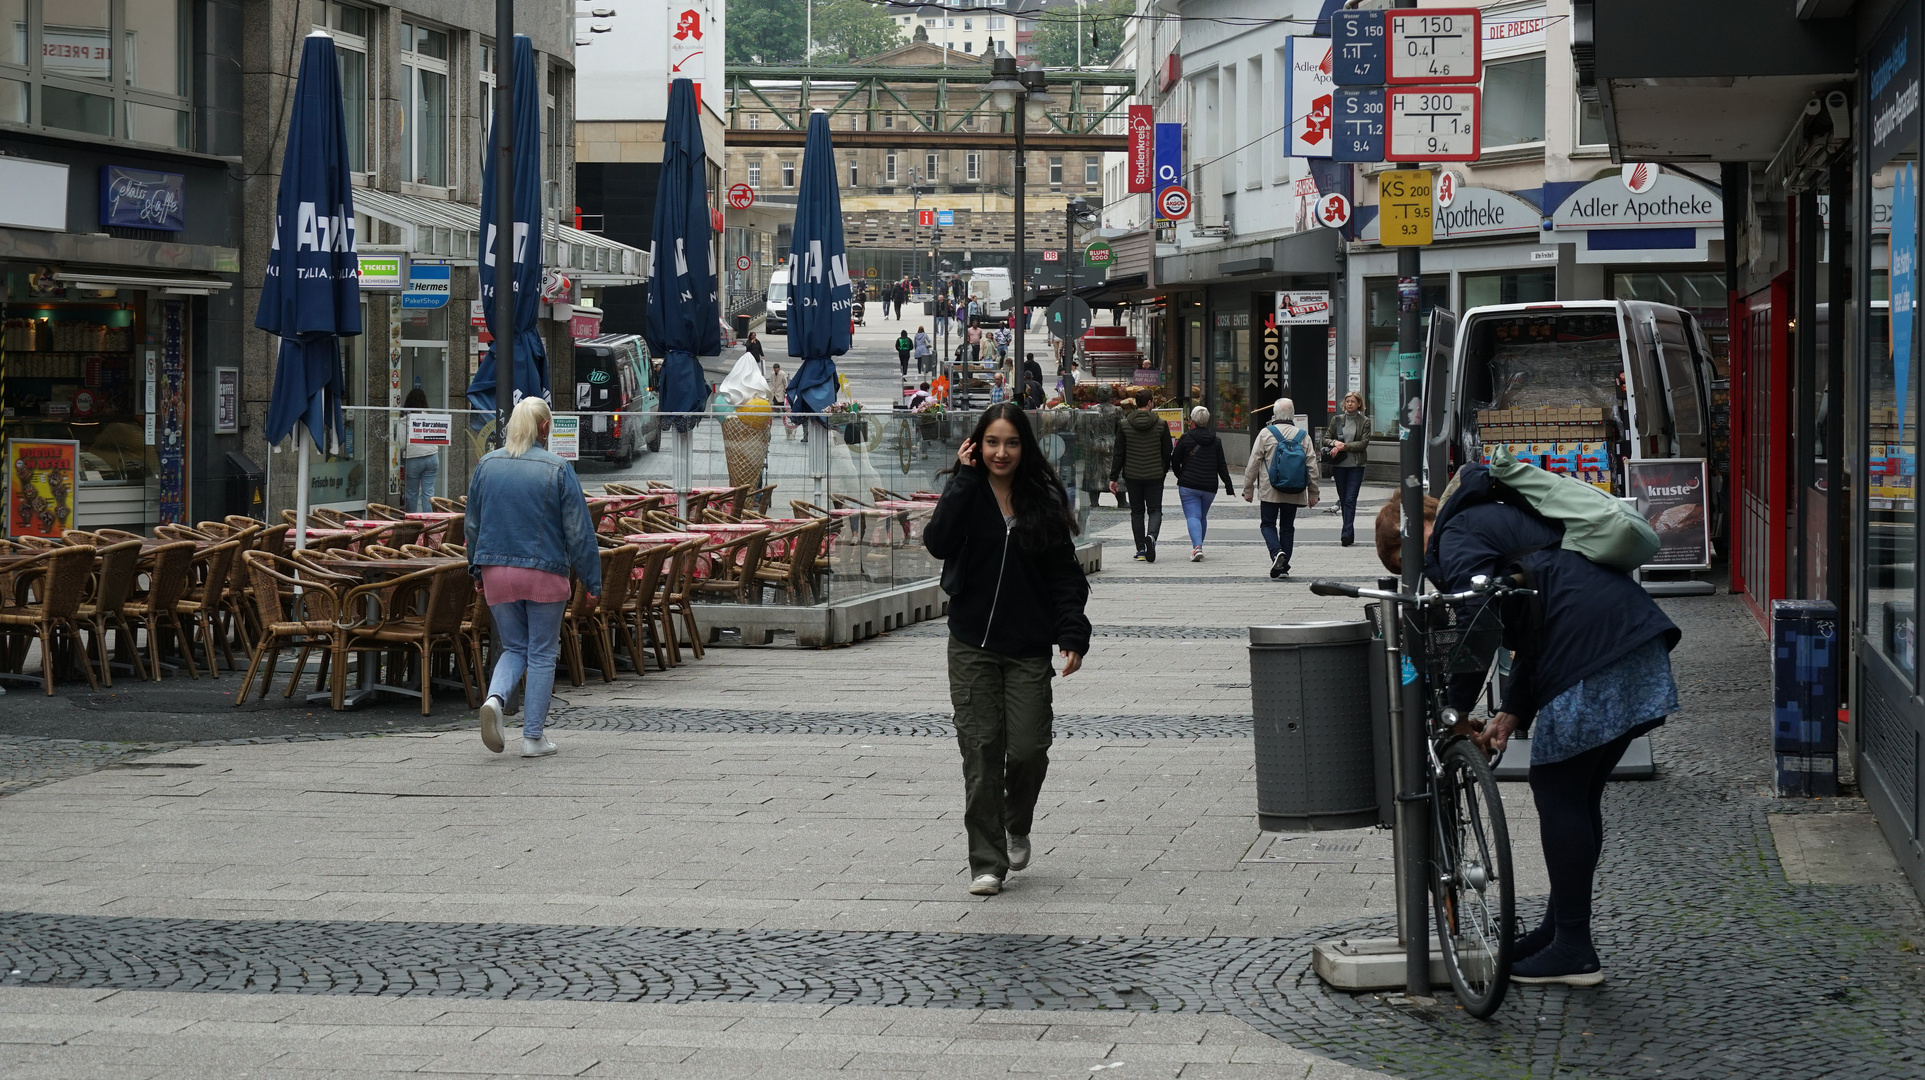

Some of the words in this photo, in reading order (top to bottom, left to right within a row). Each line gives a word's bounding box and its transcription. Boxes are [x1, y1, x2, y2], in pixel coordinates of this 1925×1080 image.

[1346, 20, 1358, 37] S
[1364, 26, 1384, 36] 150
[1393, 18, 1405, 33] H
[1420, 17, 1453, 33] 150
[1490, 25, 1505, 39] DIE
[1507, 18, 1544, 37] PREISE!
[1294, 61, 1319, 72] Adler
[1354, 64, 1371, 75] 4,7
[1346, 98, 1358, 114] S
[1363, 103, 1384, 114] 300
[1393, 95, 1405, 111] H
[1420, 95, 1453, 111] 300
[1135, 125, 1146, 184] Studienkreis
[1353, 141, 1370, 152] 9,4
[1382, 181, 1404, 197] KS
[1410, 186, 1430, 196] 200
[1570, 198, 1618, 218] Adler
[1624, 194, 1712, 222] Apotheke
[1435, 198, 1504, 237] Apotheke
[1402, 225, 1417, 234] 9,3
[415, 283, 448, 291] Hermes
[1293, 304, 1325, 314] RETTIG
[1264, 327, 1279, 389] KIOSK
[26, 459, 70, 468] WAFFEL
[312, 476, 328, 488] Frisch
[329, 478, 335, 486] to
[336, 478, 343, 488] go
[1648, 486, 1690, 496] kruste
